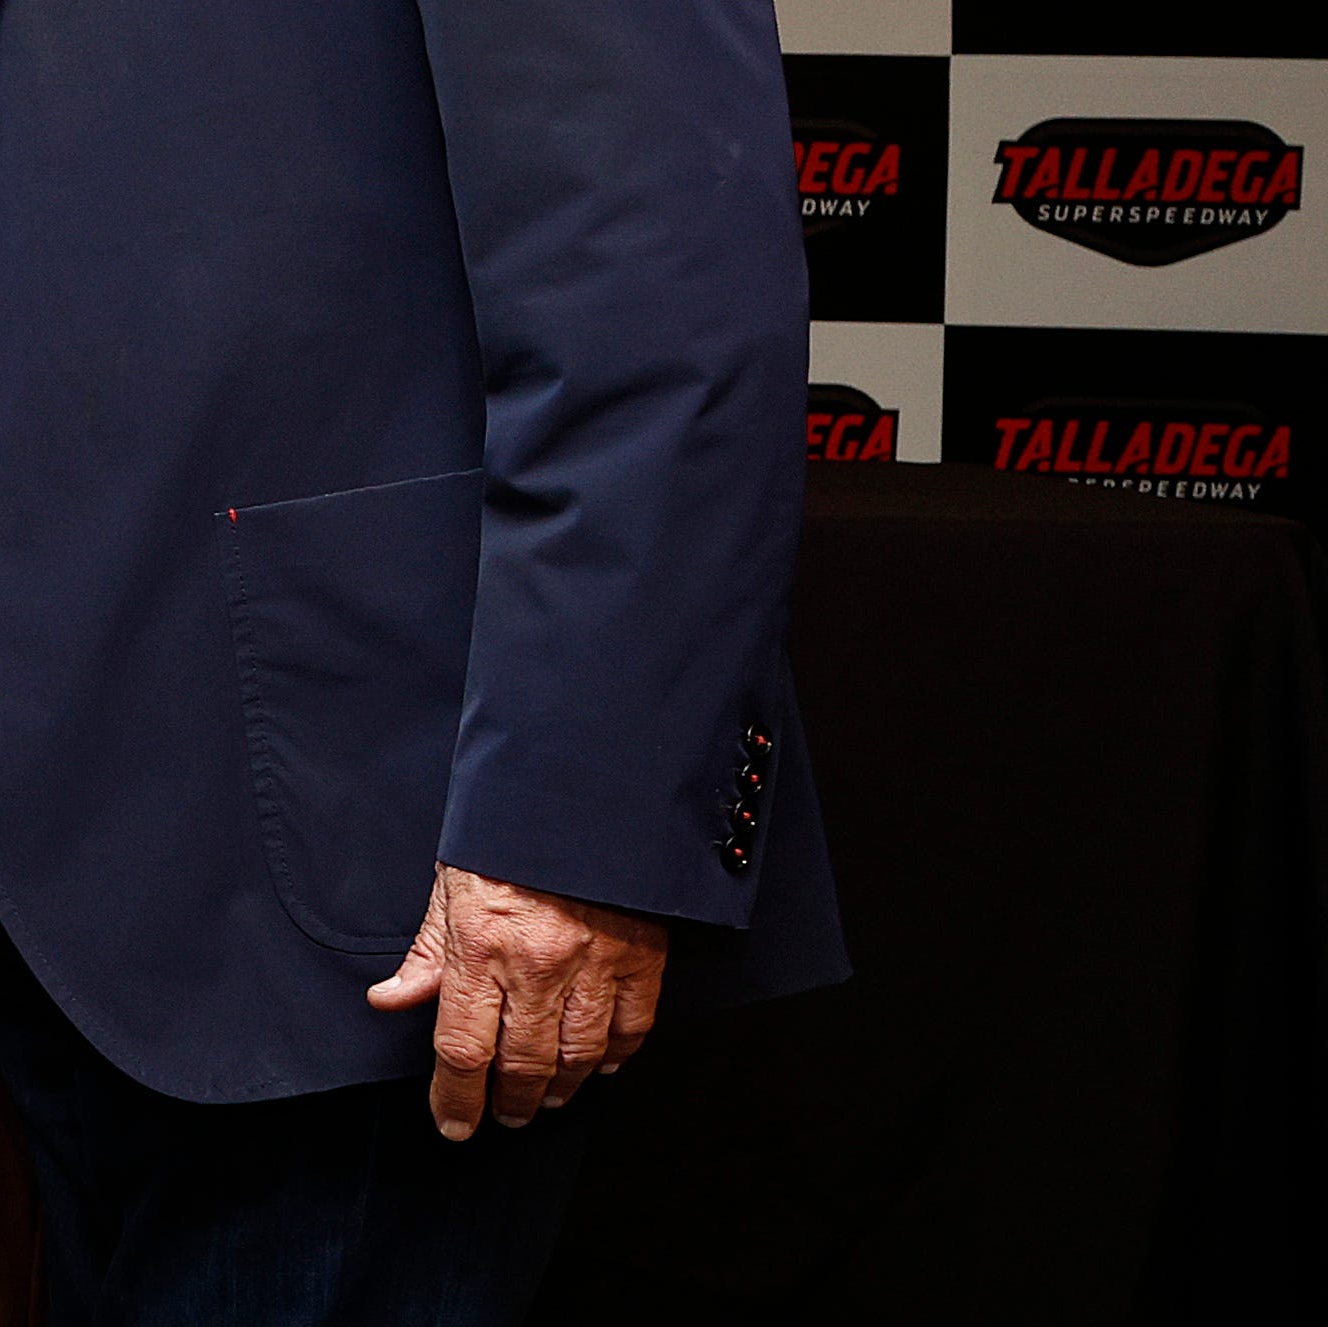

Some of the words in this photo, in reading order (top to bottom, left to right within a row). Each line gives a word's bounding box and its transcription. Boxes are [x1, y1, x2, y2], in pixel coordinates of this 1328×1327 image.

[1000, 146, 1300, 204] TALLADEGA
[1037, 203, 1269, 226] SUPERSPEEDWAY
[994, 417, 1292, 479] TALLADEGA
